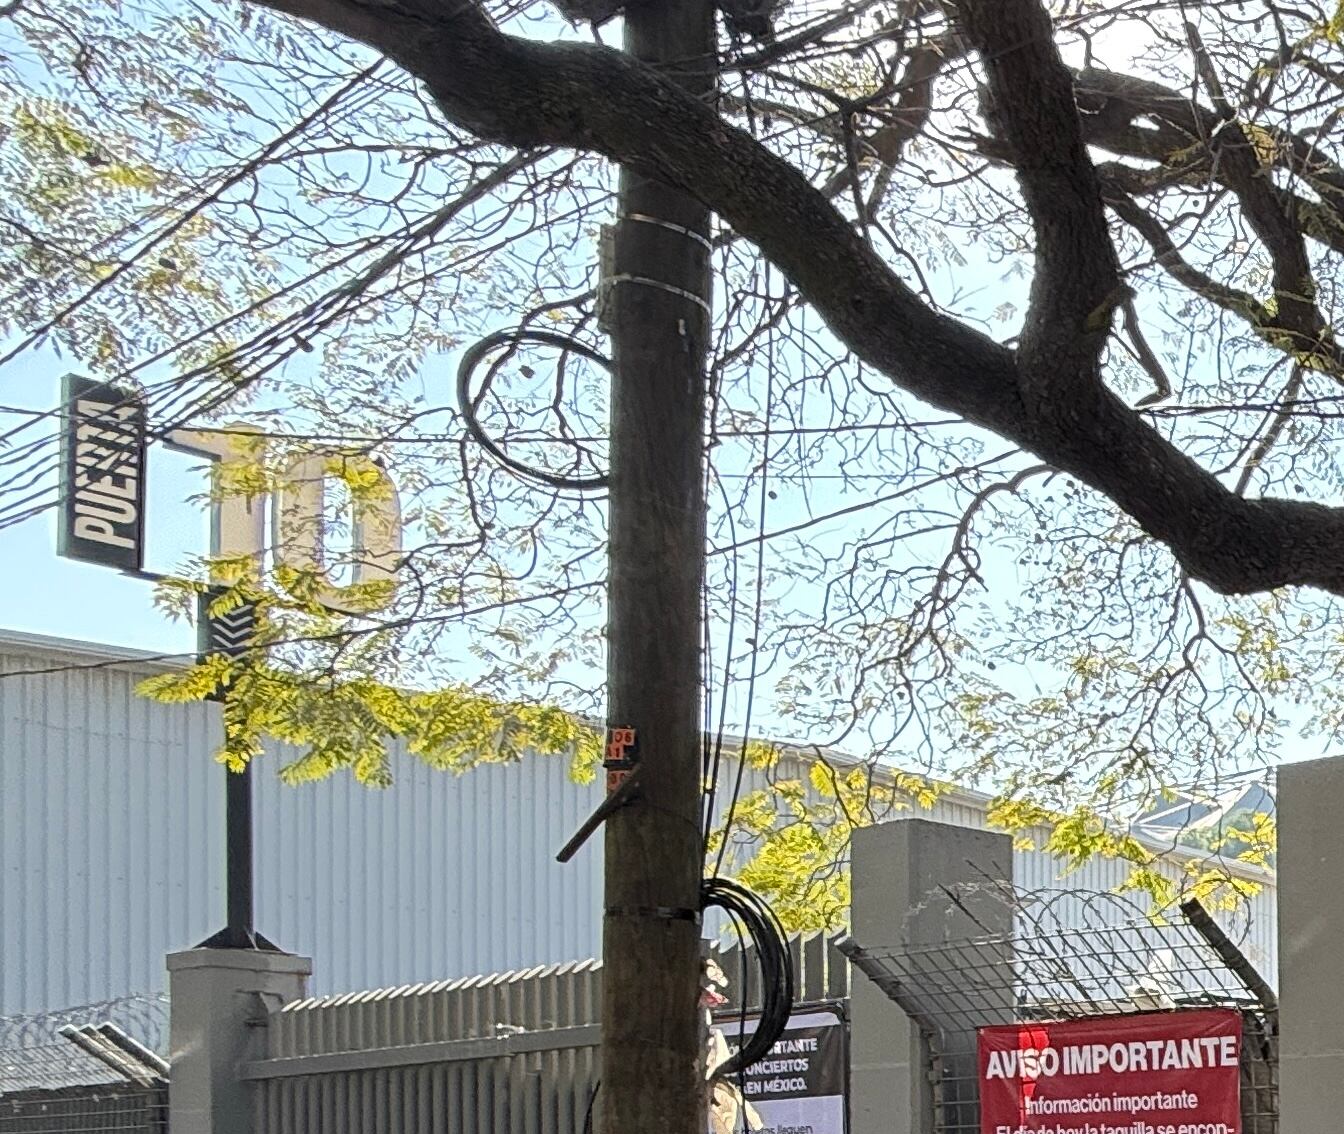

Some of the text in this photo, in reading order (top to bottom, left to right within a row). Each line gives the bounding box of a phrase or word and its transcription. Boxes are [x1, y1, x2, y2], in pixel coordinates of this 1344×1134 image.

[74, 398, 139, 550] PUERTA
[162, 421, 401, 614] 10
[744, 1058, 809, 1075] ONCIERTOS
[986, 1035, 1239, 1081] AVISO IMPORTANTE
[1025, 1090, 1198, 1116] Información importante
